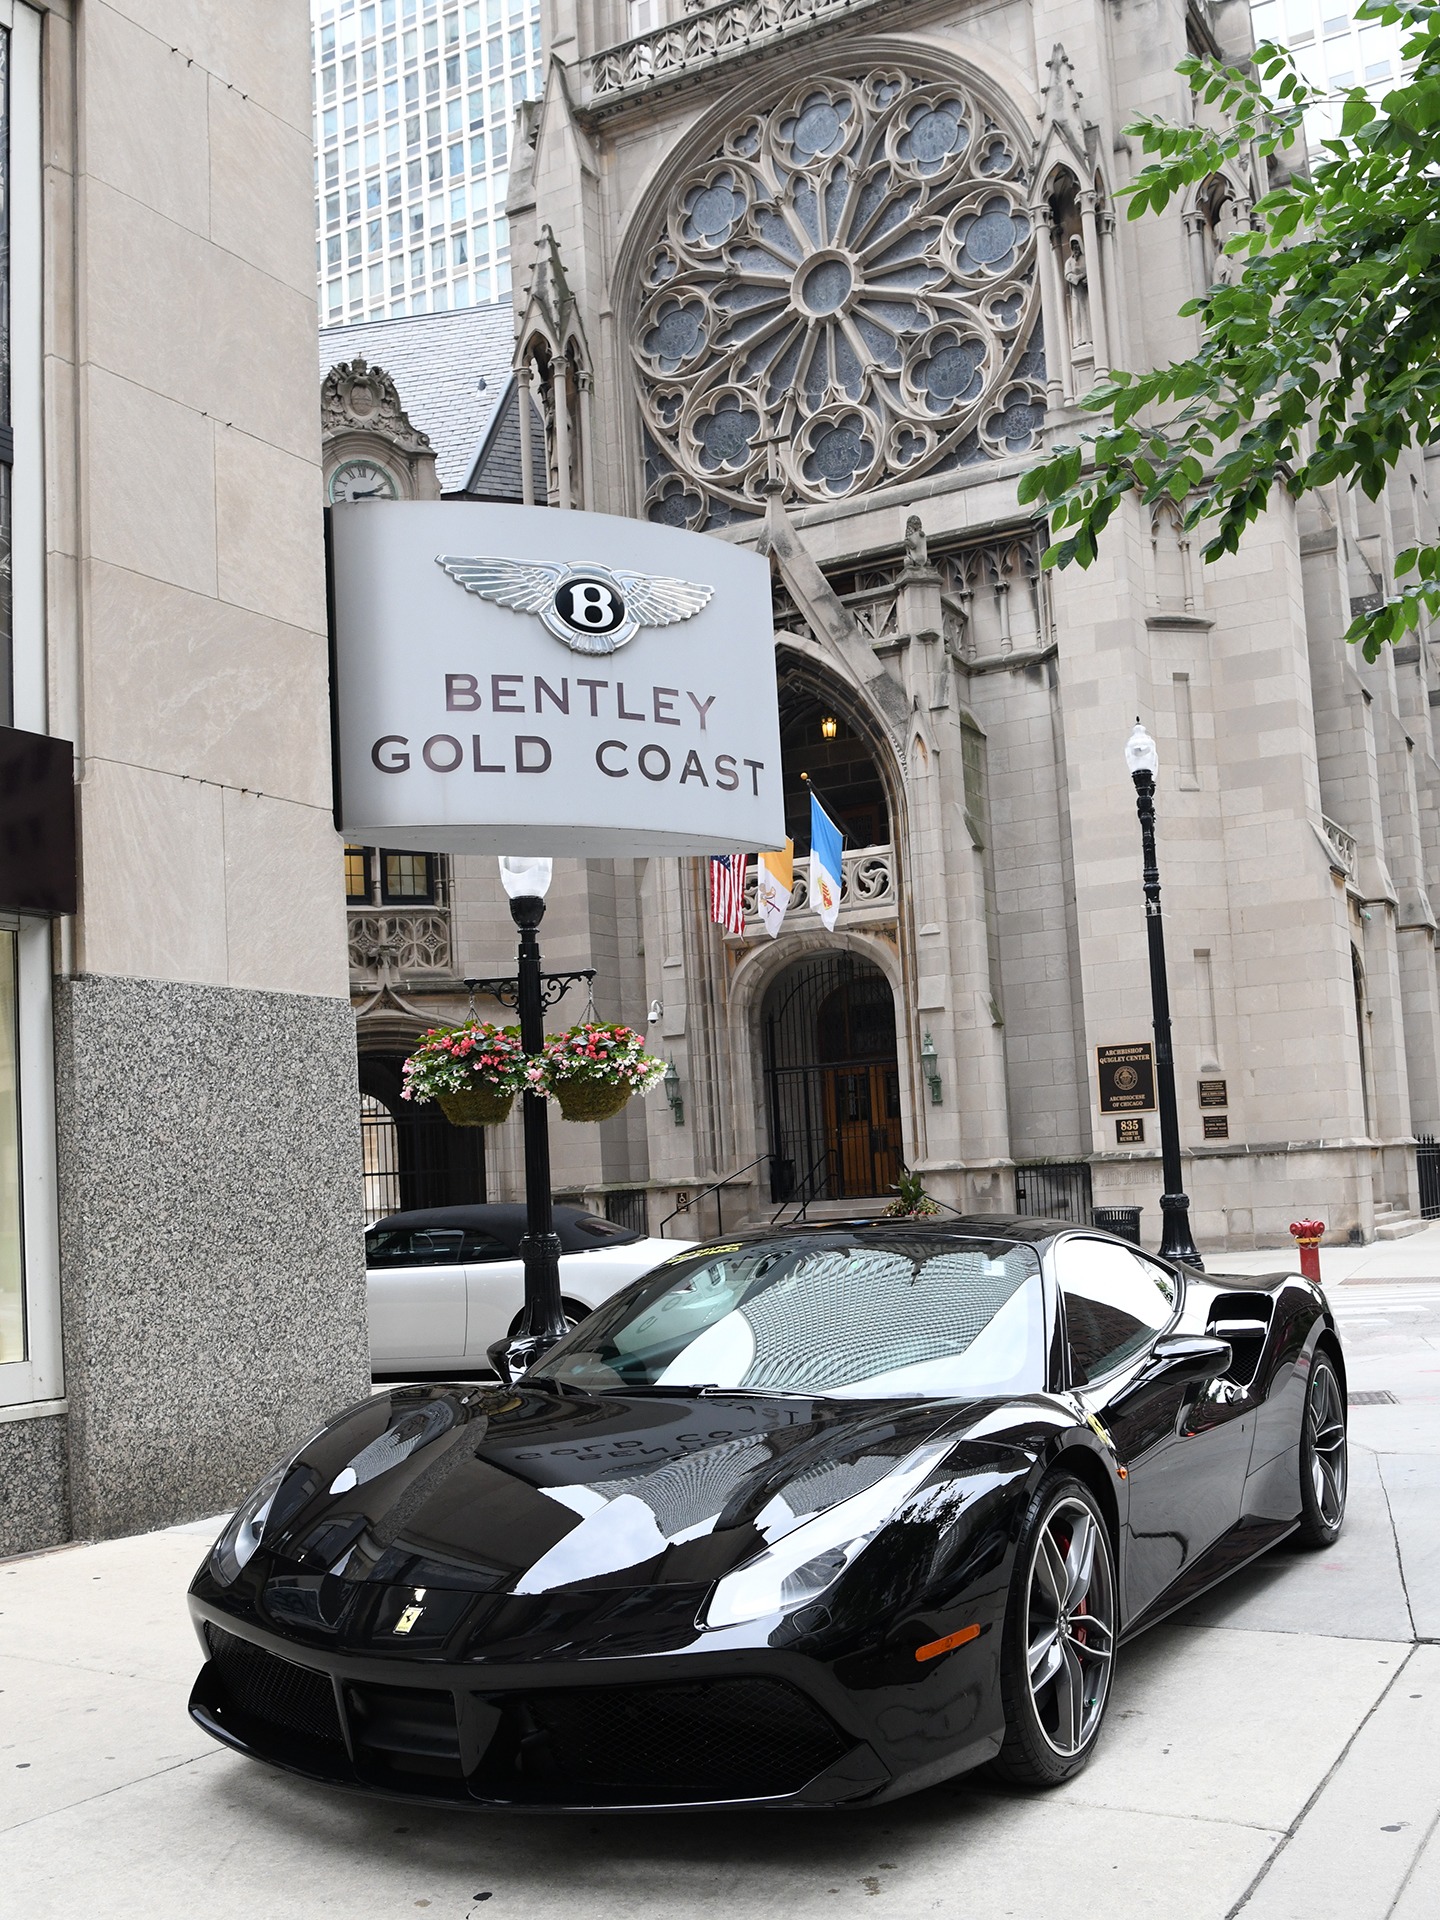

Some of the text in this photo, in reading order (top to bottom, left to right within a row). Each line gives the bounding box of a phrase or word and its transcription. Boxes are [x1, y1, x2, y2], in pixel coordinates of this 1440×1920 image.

[444, 673, 717, 730] BENTLEY
[370, 734, 765, 797] GOLD COAST
[1105, 1047, 1143, 1056] ARCHBISHOP
[1099, 1054, 1150, 1064] QUIGLEY CENTER
[1120, 1120, 1139, 1131] 835
